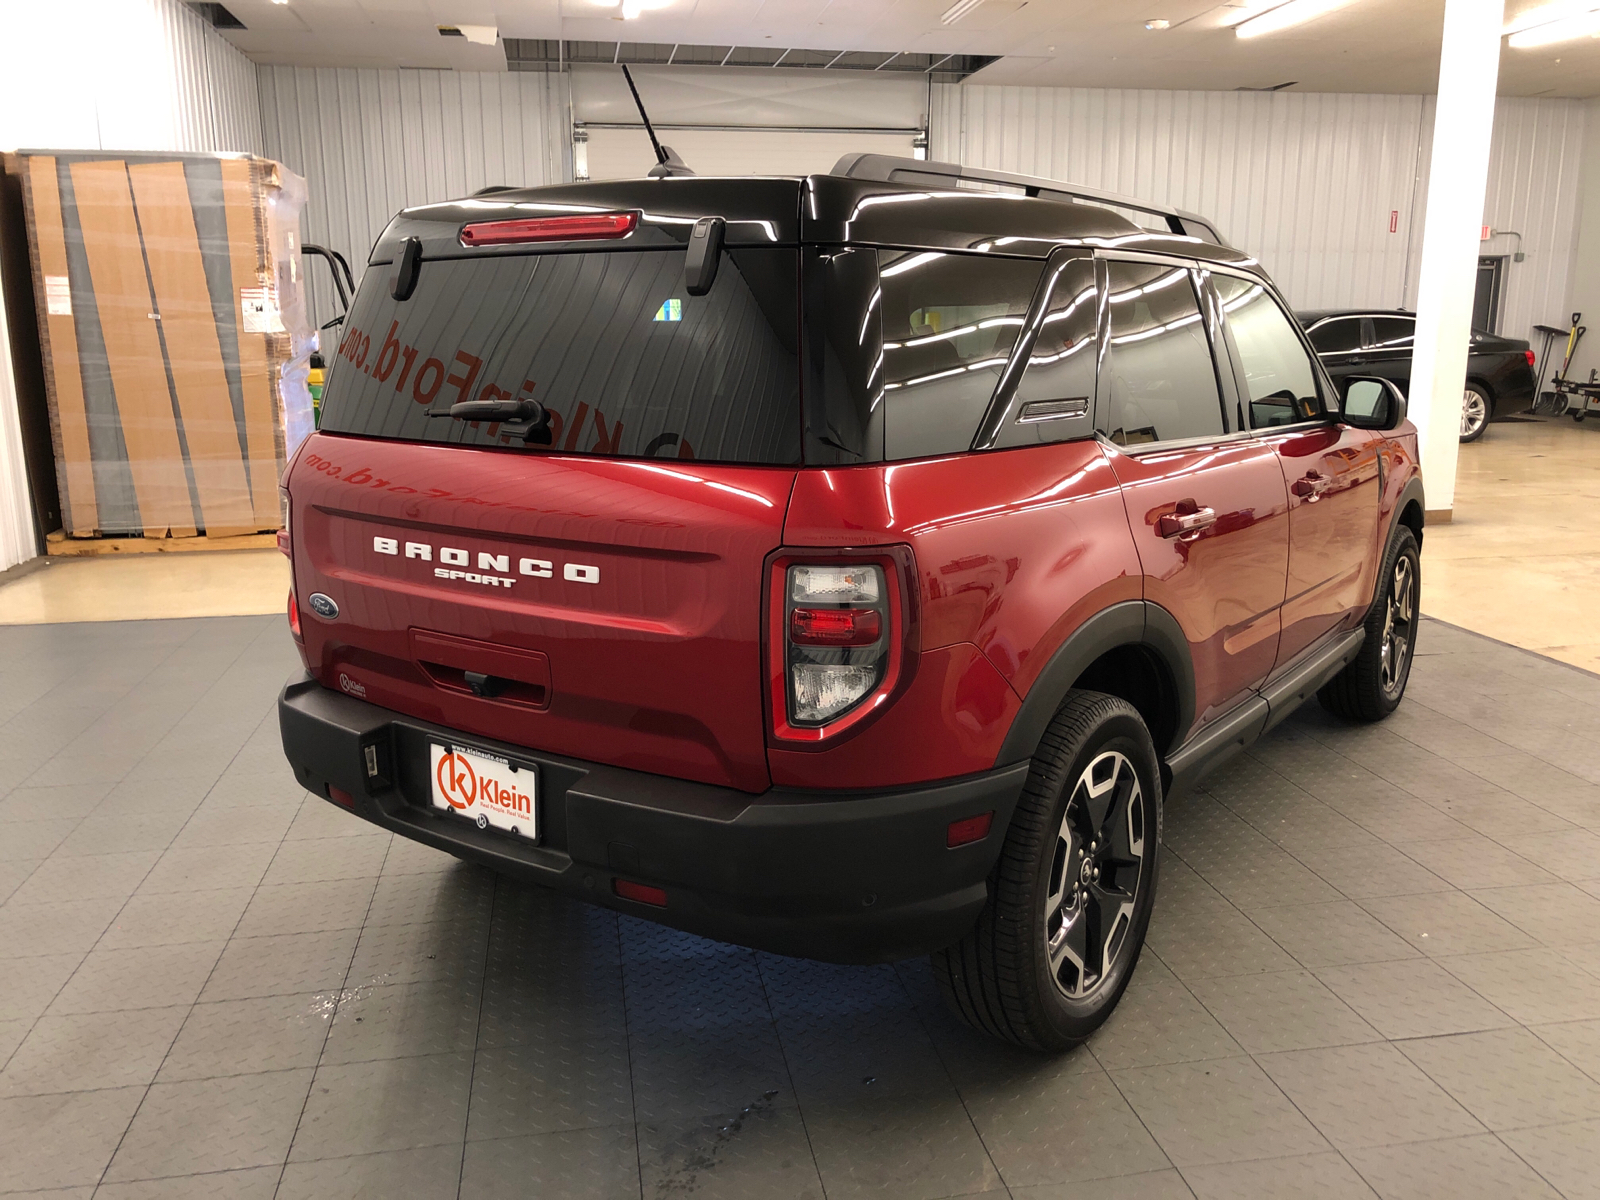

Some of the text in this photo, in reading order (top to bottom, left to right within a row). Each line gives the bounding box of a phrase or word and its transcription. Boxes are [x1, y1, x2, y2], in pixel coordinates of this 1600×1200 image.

[373, 536, 600, 584] BRONCO
[434, 567, 517, 588] SPORT
[451, 744, 509, 765] www.kleinauto.com
[479, 776, 531, 814] Klein
